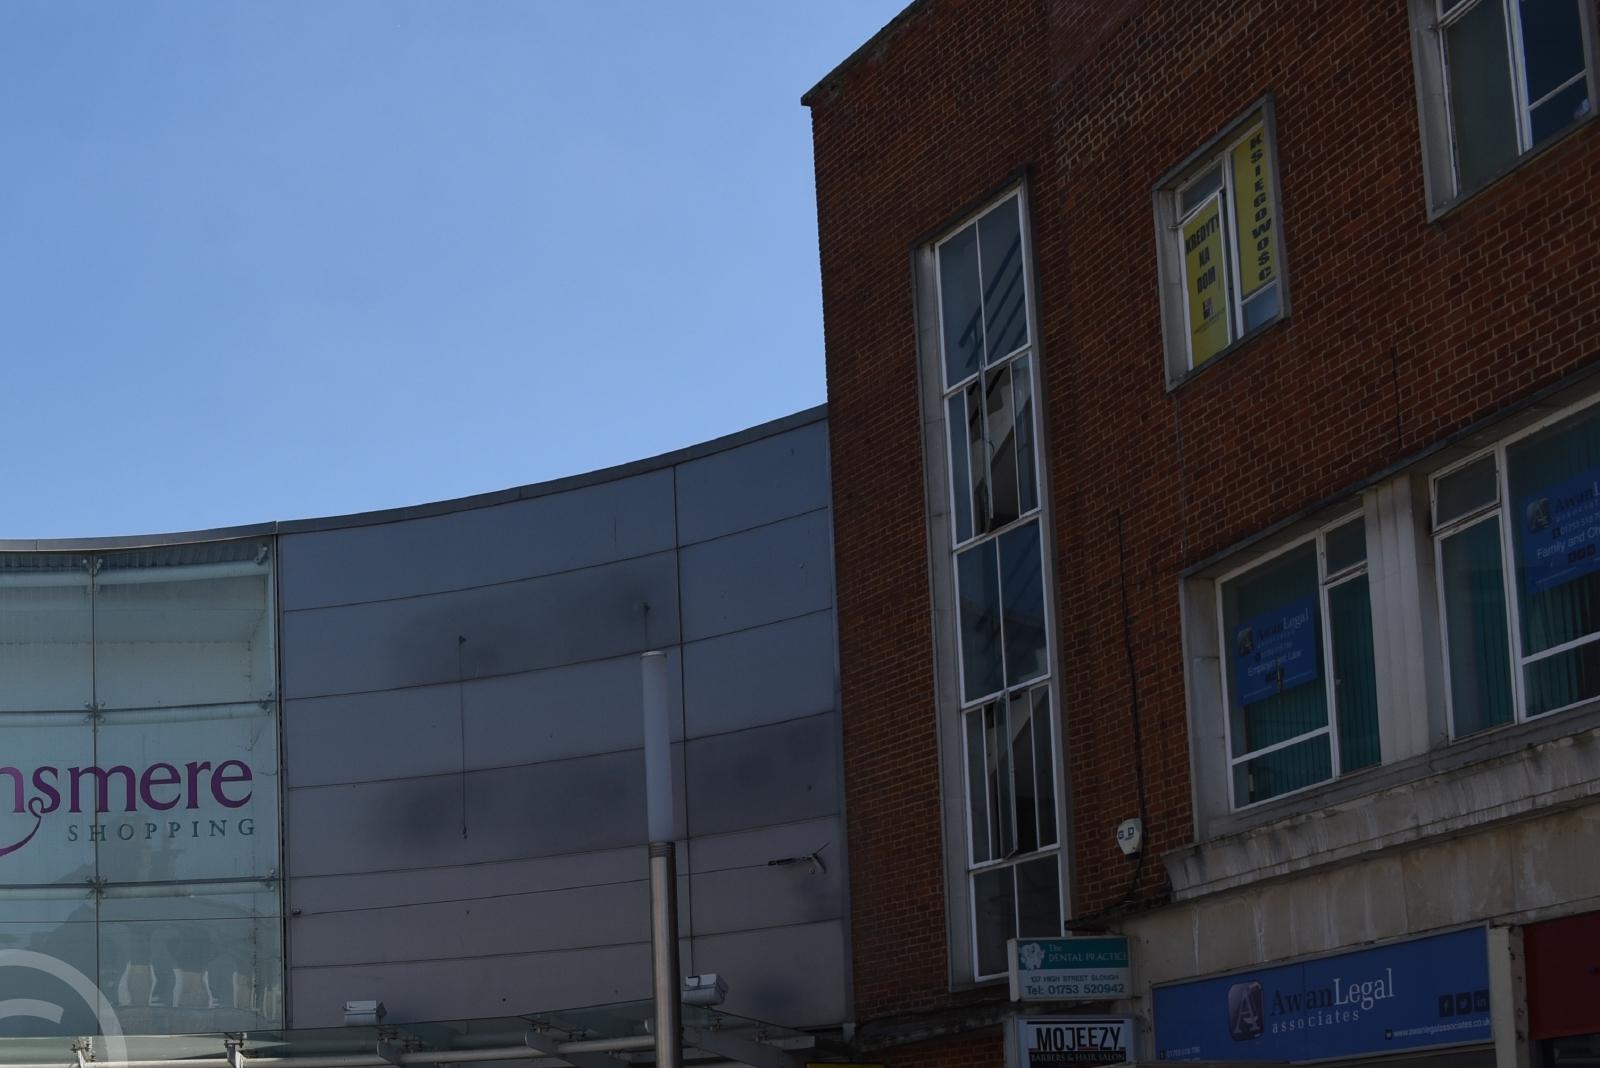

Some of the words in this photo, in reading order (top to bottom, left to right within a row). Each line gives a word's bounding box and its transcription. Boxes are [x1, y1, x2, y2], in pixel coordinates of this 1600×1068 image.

[1199, 246, 1210, 268] NA
[1197, 265, 1216, 295] DOM
[67, 818, 256, 842] SHOPPING
[1048, 952, 1082, 962] DENTAL
[1047, 984, 1079, 995] 01753
[1084, 983, 1125, 994] 520942
[1272, 1008, 1360, 1034] associates
[1036, 1026, 1121, 1051] MOJEEZY
